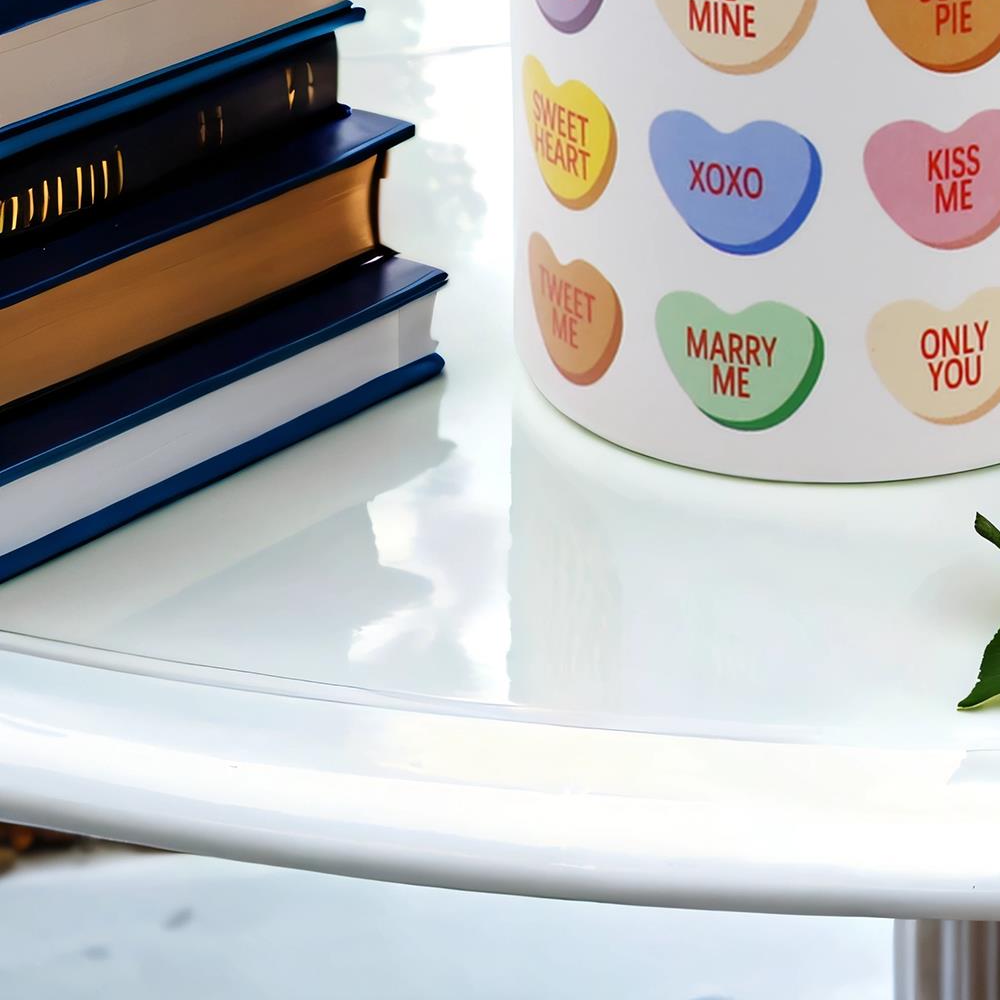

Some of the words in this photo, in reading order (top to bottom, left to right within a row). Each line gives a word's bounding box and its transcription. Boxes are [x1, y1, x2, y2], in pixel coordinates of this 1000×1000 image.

[936, 1, 972, 36] PIE
[533, 89, 589, 147] SWEET
[535, 123, 591, 180] HEART
[928, 144, 981, 182] KISS
[689, 160, 763, 199] XOXO
[935, 179, 973, 214] ME
[539, 264, 596, 324] TWEET
[552, 308, 578, 349] ME
[687, 326, 777, 368] MARRY
[920, 320, 989, 359] ONLY
[713, 364, 750, 399] ME
[928, 355, 982, 392] YOU
